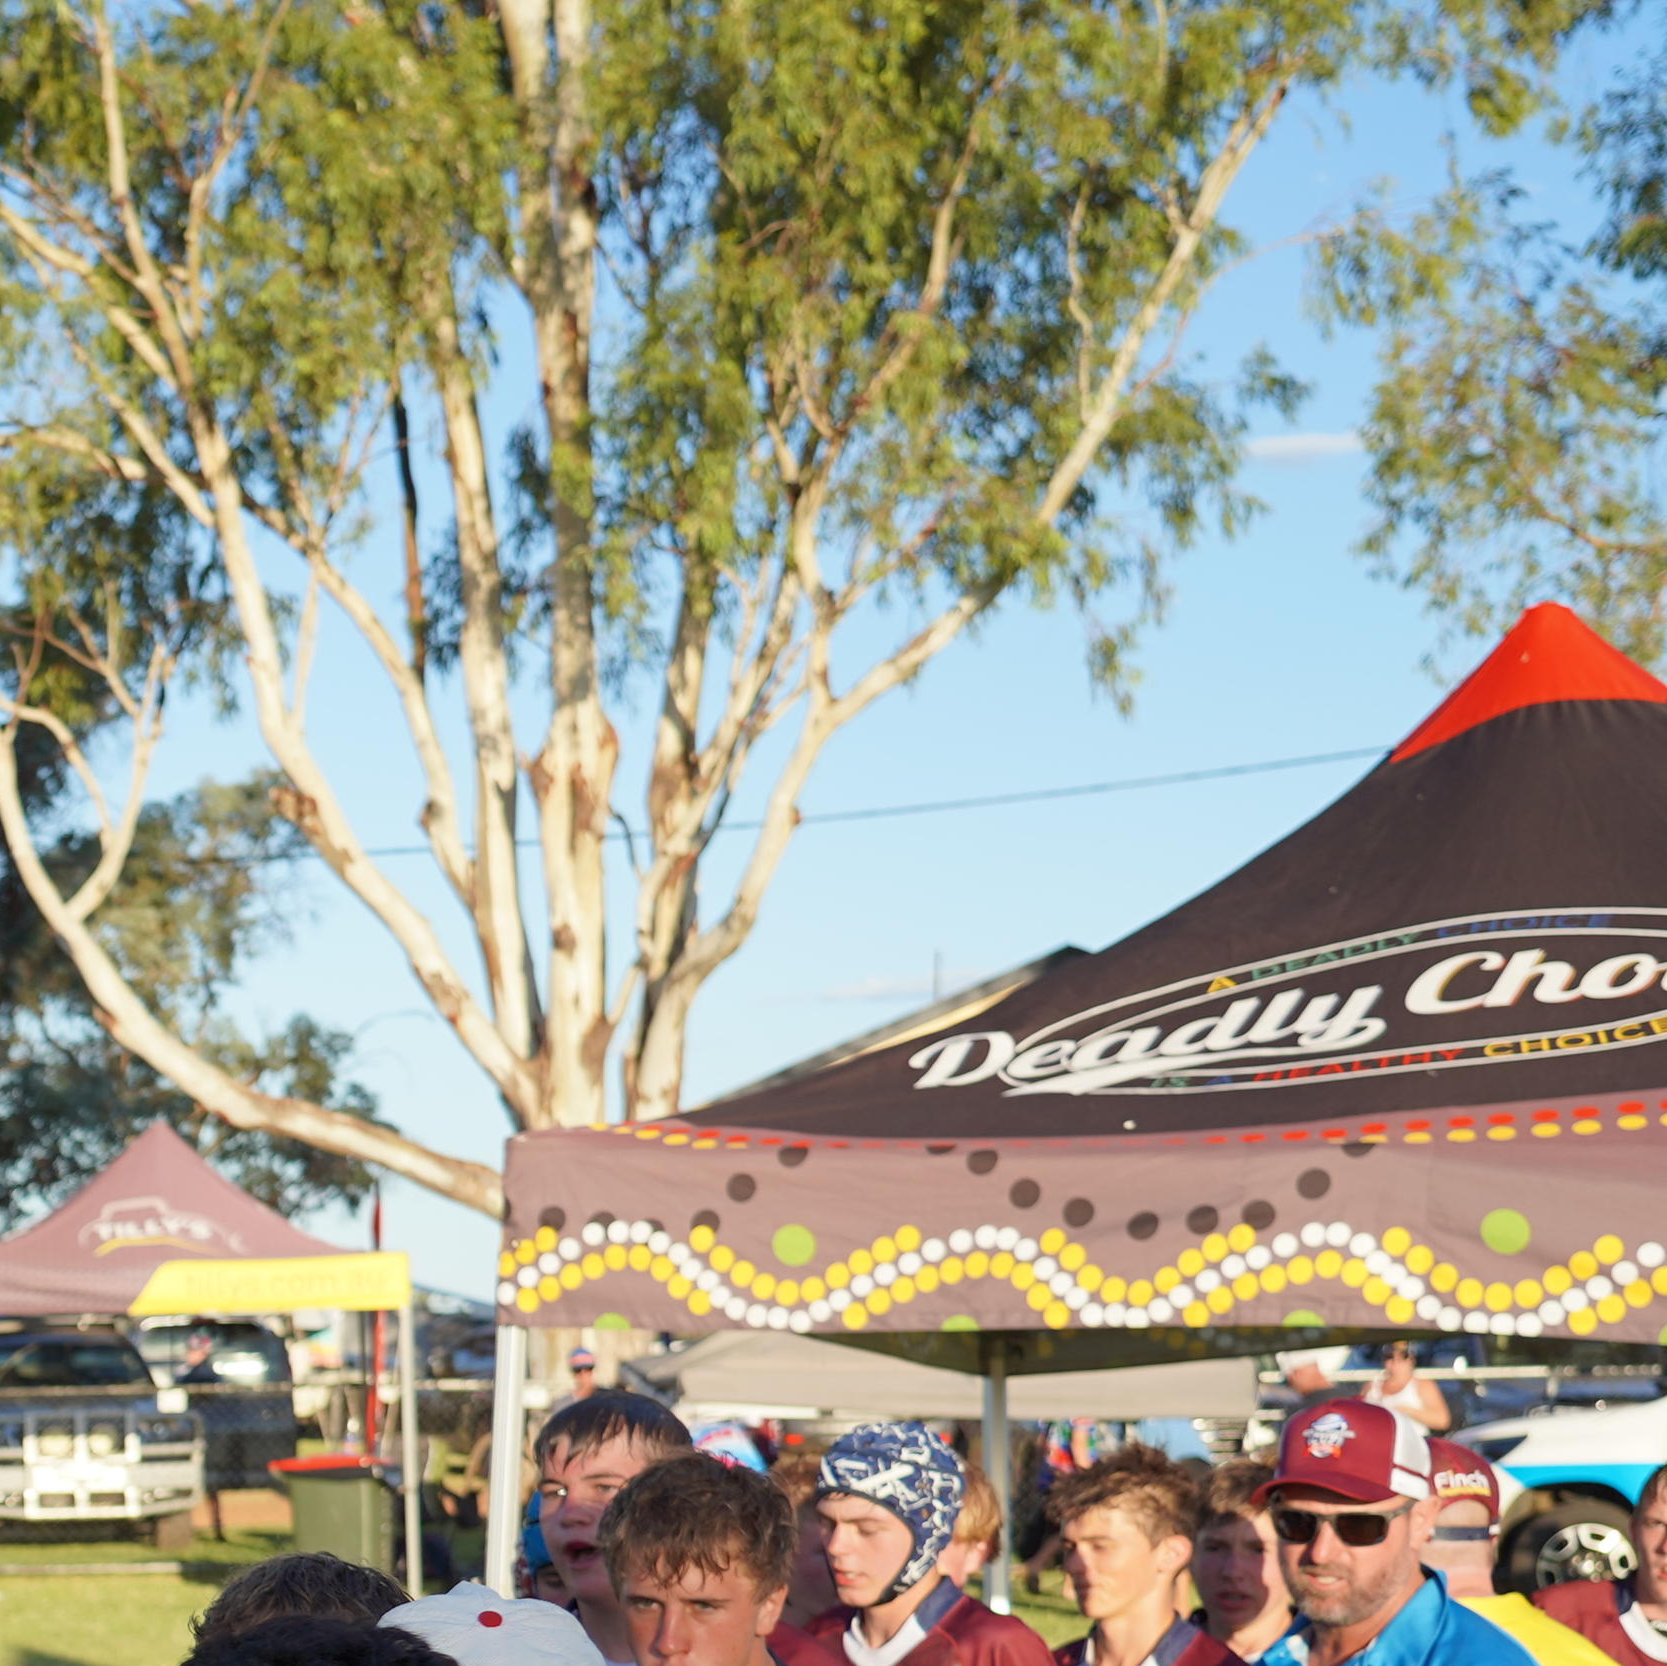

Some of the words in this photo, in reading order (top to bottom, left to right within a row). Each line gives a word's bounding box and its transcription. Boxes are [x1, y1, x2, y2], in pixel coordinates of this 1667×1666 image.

[1251, 931, 1419, 980] DEADLY
[1437, 914, 1612, 938] CHOICE
[908, 985, 1387, 1098] Deadly
[1405, 948, 1667, 1016] Cho
[1252, 1047, 1466, 1083] HEALTHY
